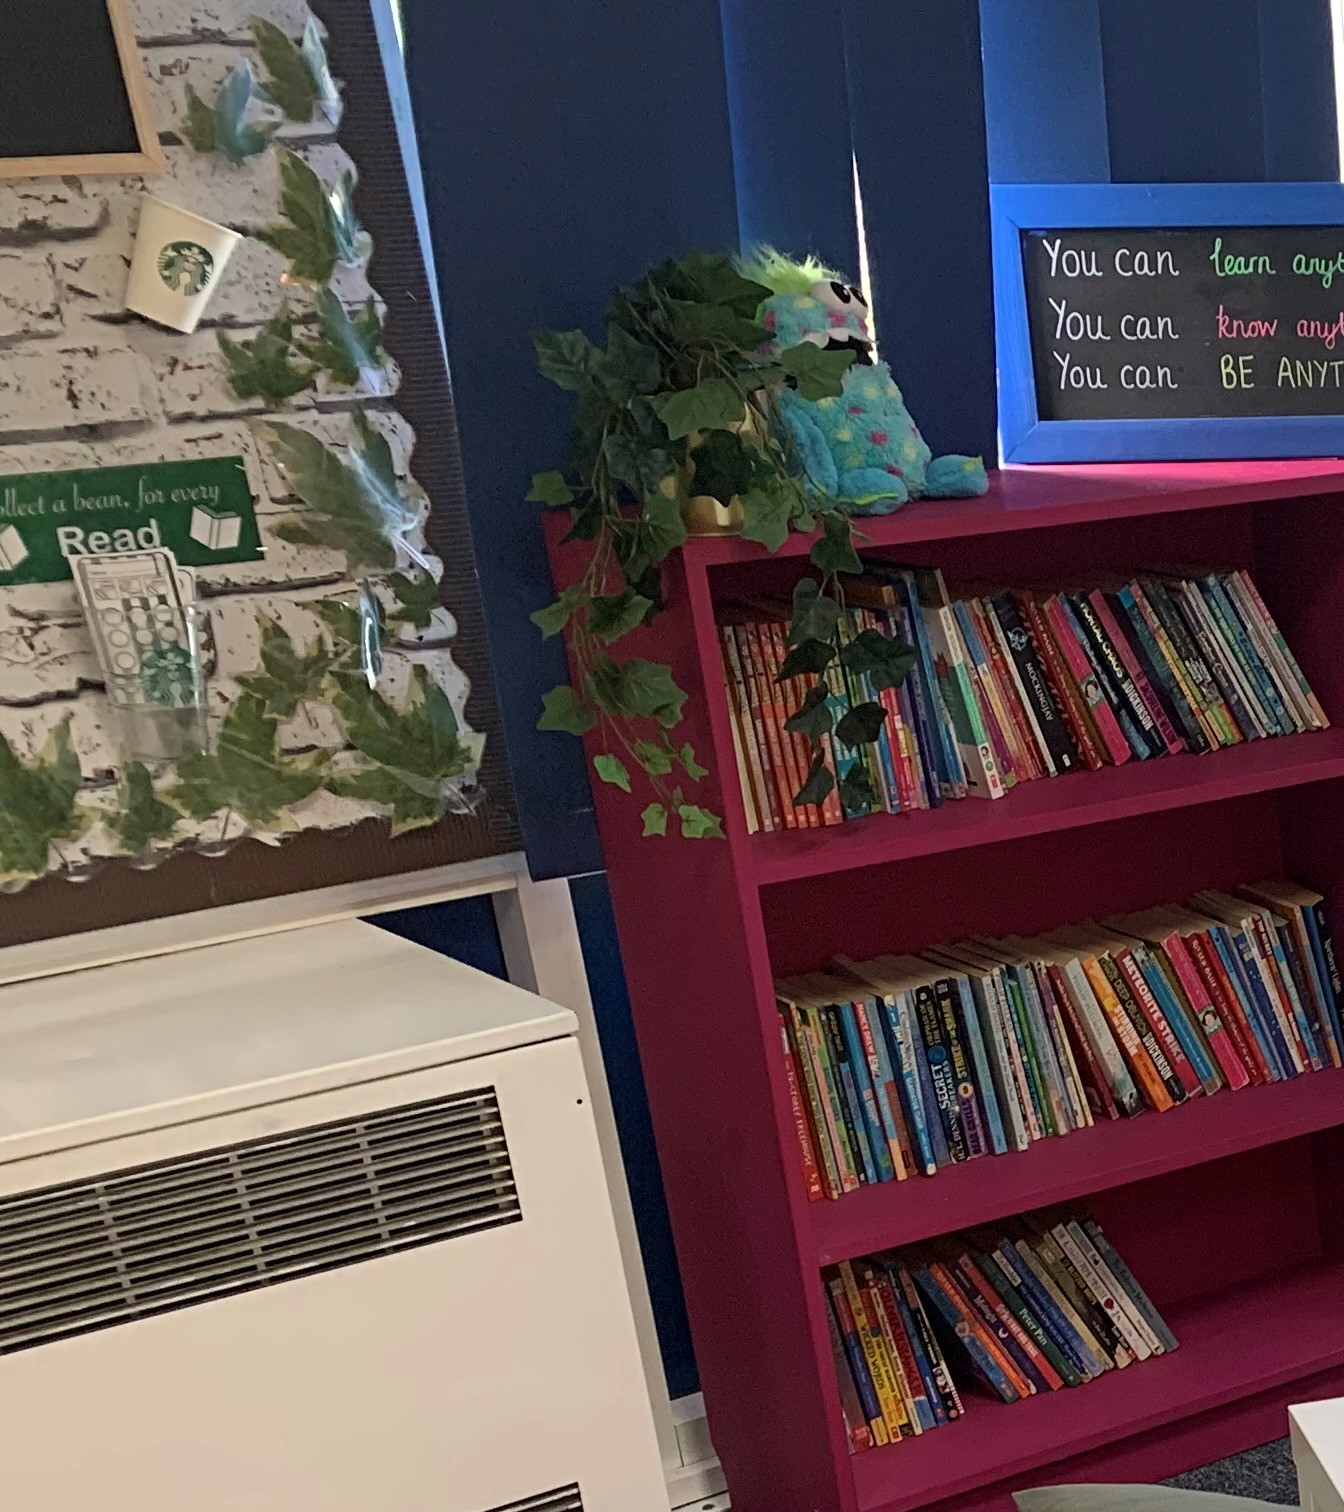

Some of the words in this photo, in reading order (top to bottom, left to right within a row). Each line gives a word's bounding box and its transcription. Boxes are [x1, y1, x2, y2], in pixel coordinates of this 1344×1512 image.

[1042, 239, 1103, 278] You
[1115, 248, 1180, 277] can
[1209, 237, 1276, 278] learn
[1048, 299, 1111, 341] You
[1120, 311, 1180, 340] can
[1215, 304, 1279, 339] know
[1053, 352, 1108, 390] You
[1120, 360, 1179, 390] can
[1221, 355, 1254, 390] BE
[52, 498, 67, 513] a
[136, 475, 164, 513] for
[170, 484, 219, 506] every
[56, 518, 162, 556] Read
[1102, 642, 1124, 679] CHAOS
[1025, 662, 1054, 721] MOCKINGJAY
[1122, 955, 1163, 1022] METEORITE
[1157, 1017, 1187, 1064] STRIKE
[1144, 1035, 1174, 1081] DICKINSON
[931, 1063, 950, 1110] SECRET
[1019, 1308, 1038, 1334] Peter
[1034, 1329, 1048, 1346] Pan
[860, 1325, 876, 1358] WICKED
[869, 1354, 886, 1390] WORDS
